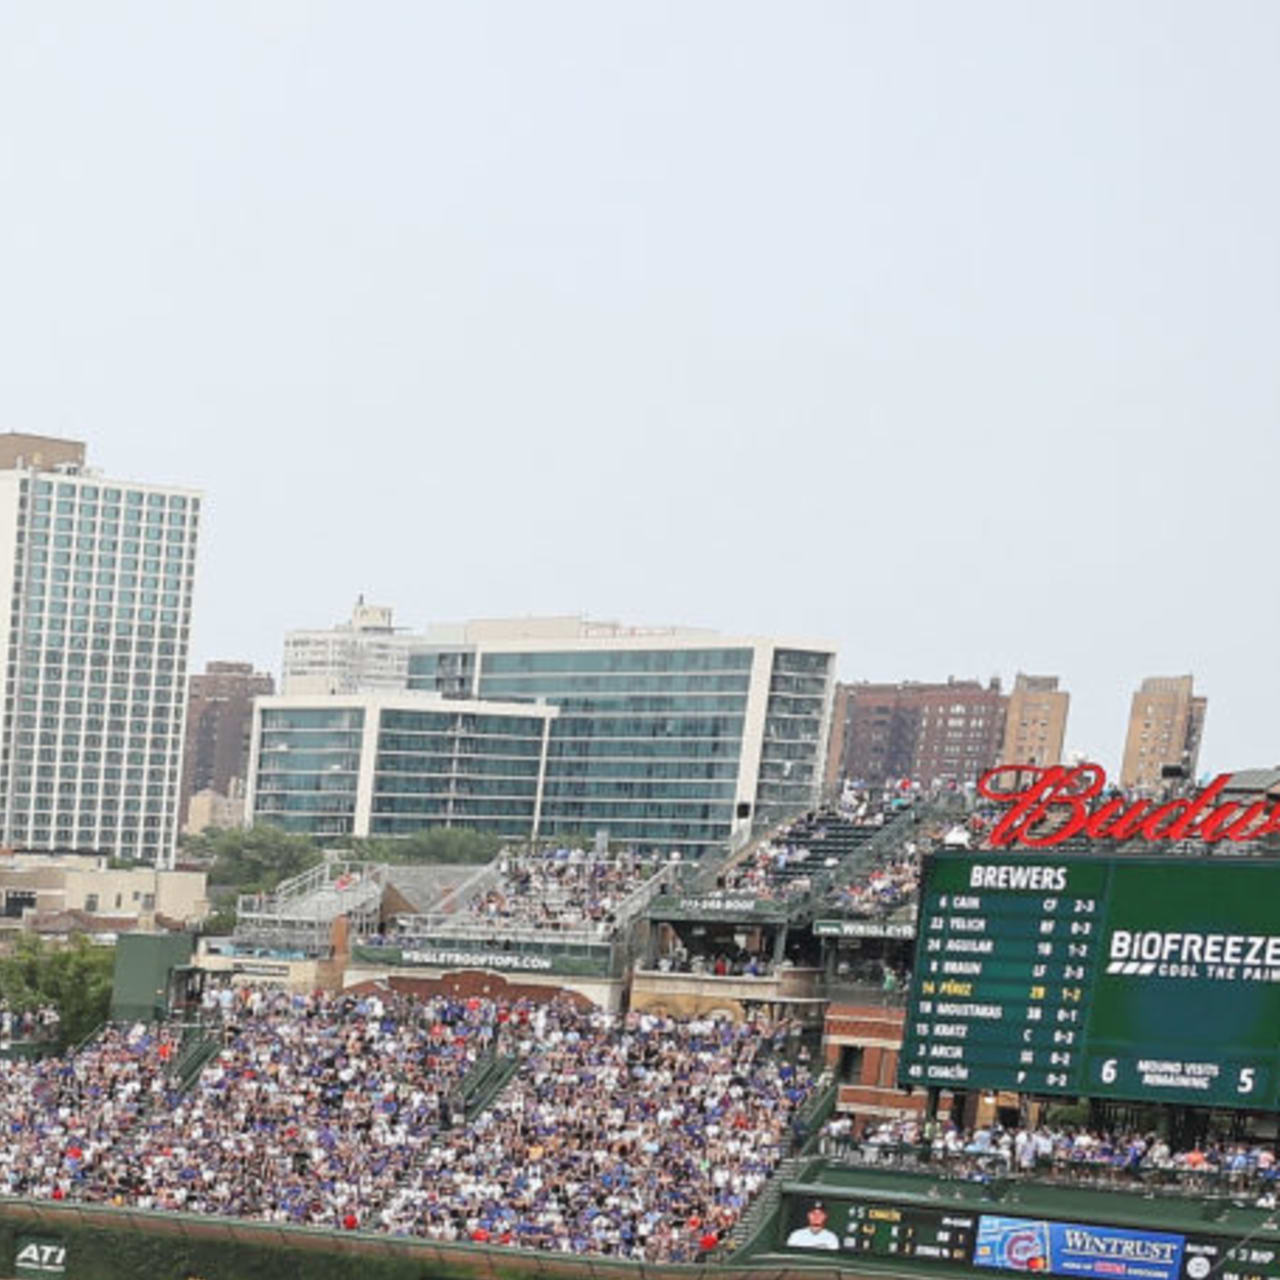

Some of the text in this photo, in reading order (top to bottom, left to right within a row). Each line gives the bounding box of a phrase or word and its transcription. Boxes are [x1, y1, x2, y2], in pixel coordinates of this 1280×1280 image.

[970, 865, 1067, 890] BREWERS
[1110, 930, 1280, 966] BIOFREEZE
[1158, 964, 1199, 977] COOL
[1206, 965, 1235, 979] THE
[1101, 1059, 1118, 1084] 6
[1237, 1068, 1255, 1093] 5
[17, 1243, 66, 1264] ATI
[1064, 1229, 1178, 1259] WINTRUST
